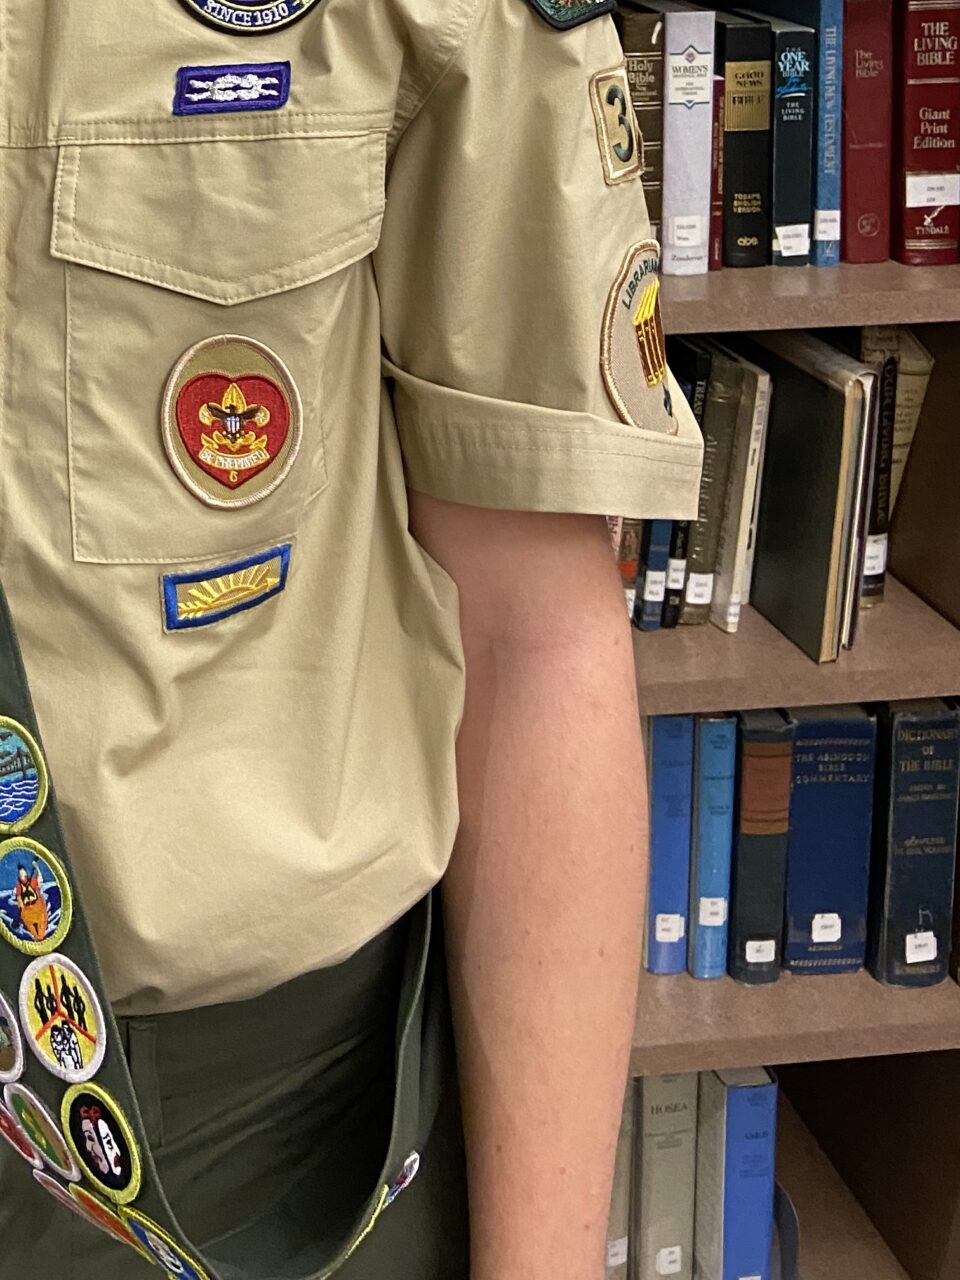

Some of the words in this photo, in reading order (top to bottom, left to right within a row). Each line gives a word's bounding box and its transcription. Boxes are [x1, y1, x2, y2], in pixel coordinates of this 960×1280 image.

[204, 0, 253, 26] SINCE
[254, 2, 290, 26] 1910
[921, 21, 949, 36] THE
[914, 36, 958, 52] LIVING
[781, 51, 807, 62] ONE
[917, 51, 955, 66] BIBLE
[629, 60, 654, 72] Holy
[778, 61, 810, 72] YEAR
[628, 72, 655, 83] Bible
[824, 86, 836, 109] NEW
[919, 107, 950, 120] Giant
[606, 84, 634, 162] 3
[920, 121, 949, 135] Print
[913, 136, 956, 150] Edition
[796, 754, 814, 763] THE
[817, 753, 870, 763] ABINGDON
[900, 760, 920, 772] THE
[796, 775, 870, 784] COMMENTARY
[651, 1102, 688, 1115] HOSEA
